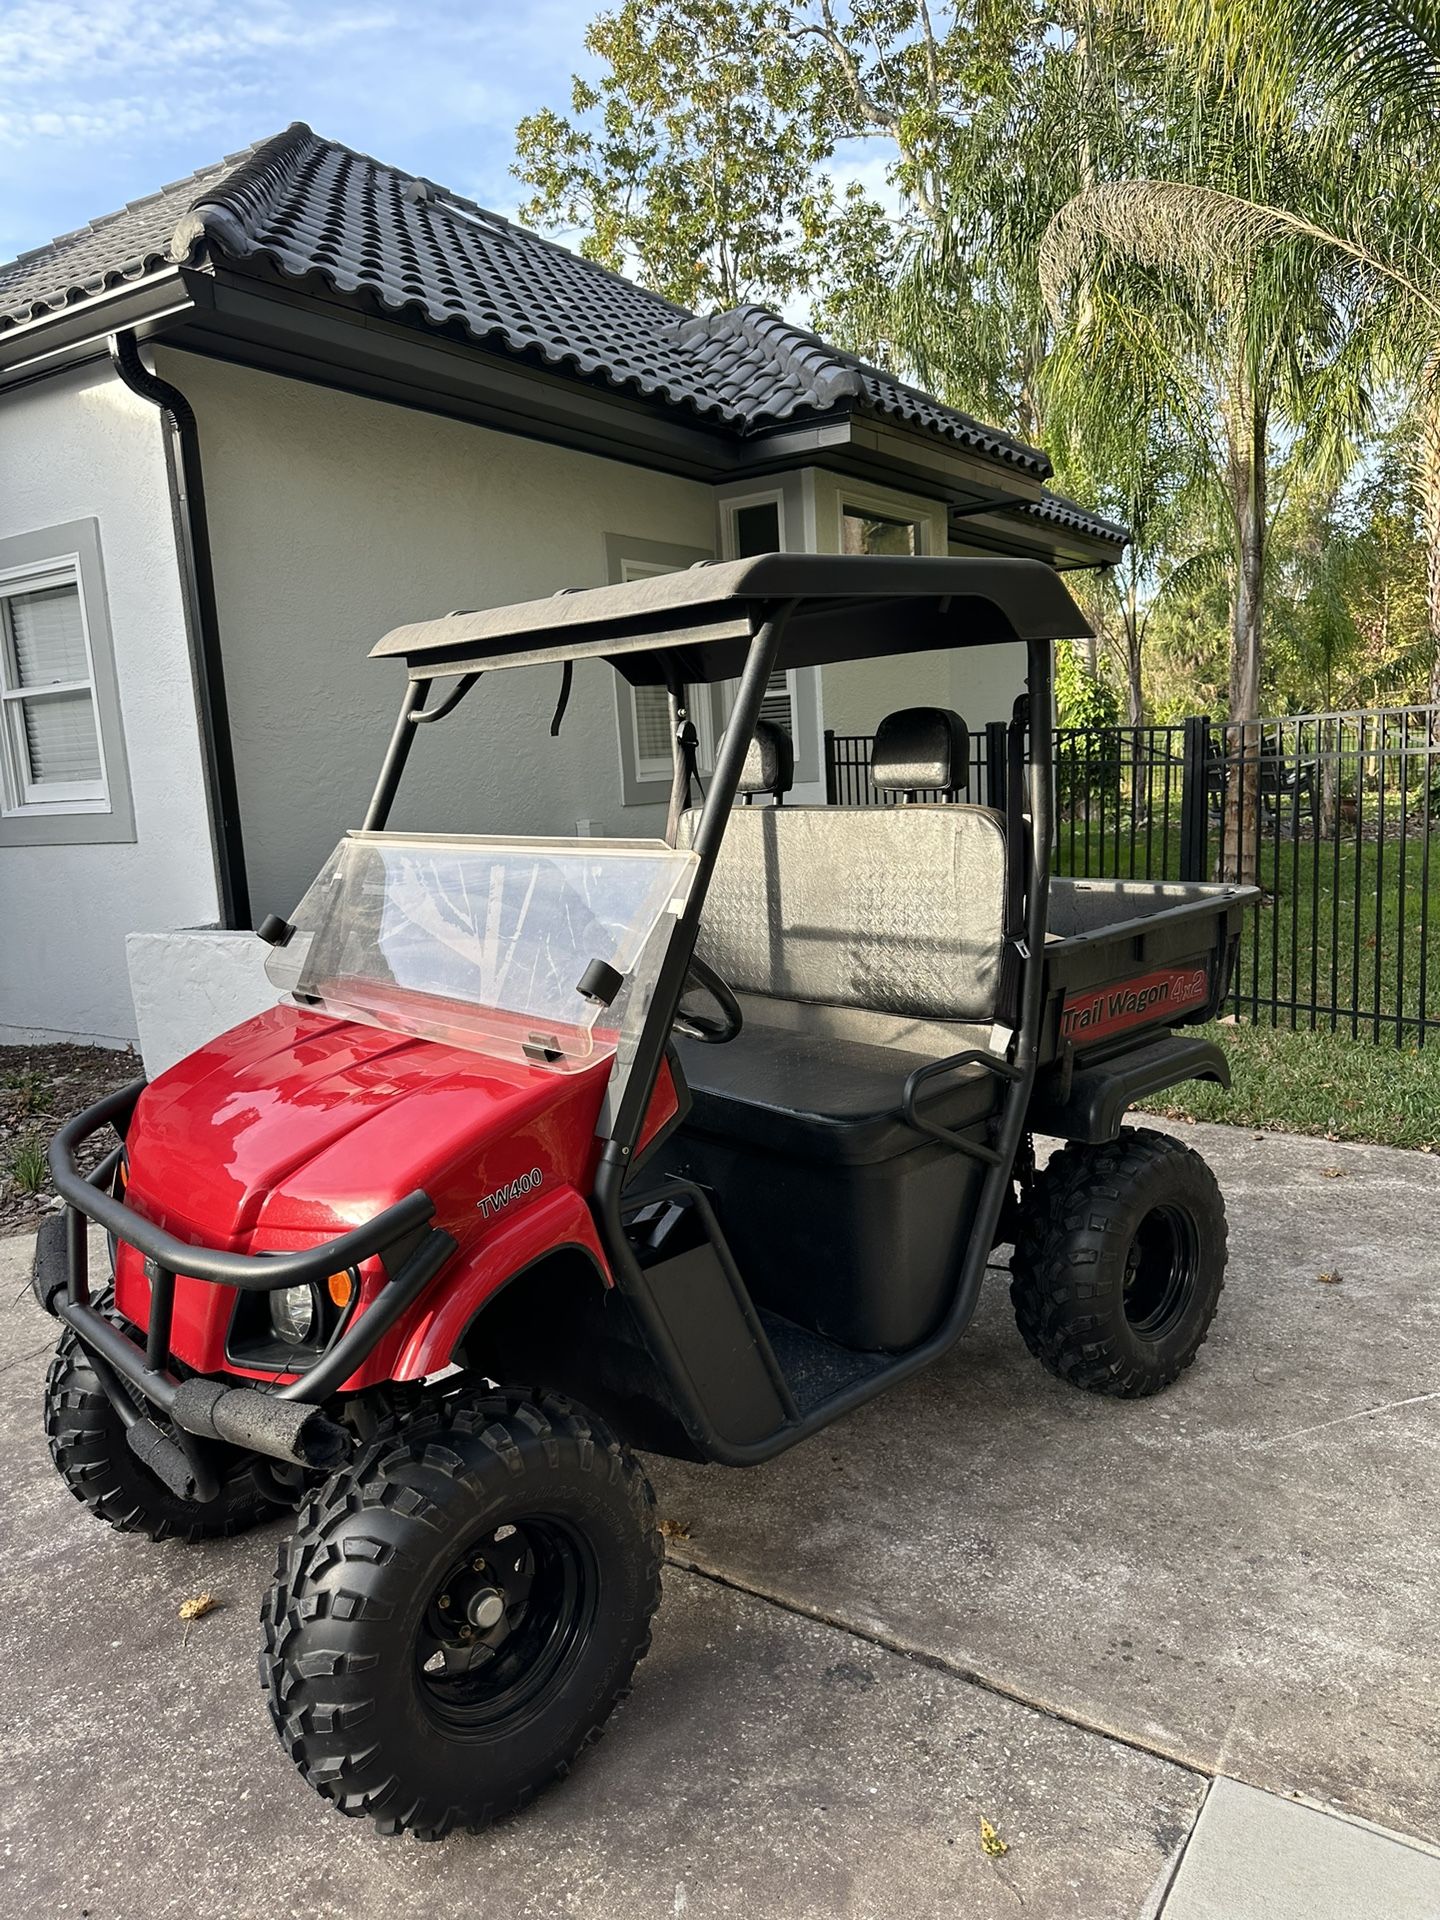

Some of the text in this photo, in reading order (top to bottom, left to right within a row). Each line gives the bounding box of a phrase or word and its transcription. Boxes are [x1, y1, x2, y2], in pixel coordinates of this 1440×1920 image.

[1062, 970, 1205, 1036] Trail Wagon 4x2
[476, 1167, 543, 1219] TW400
